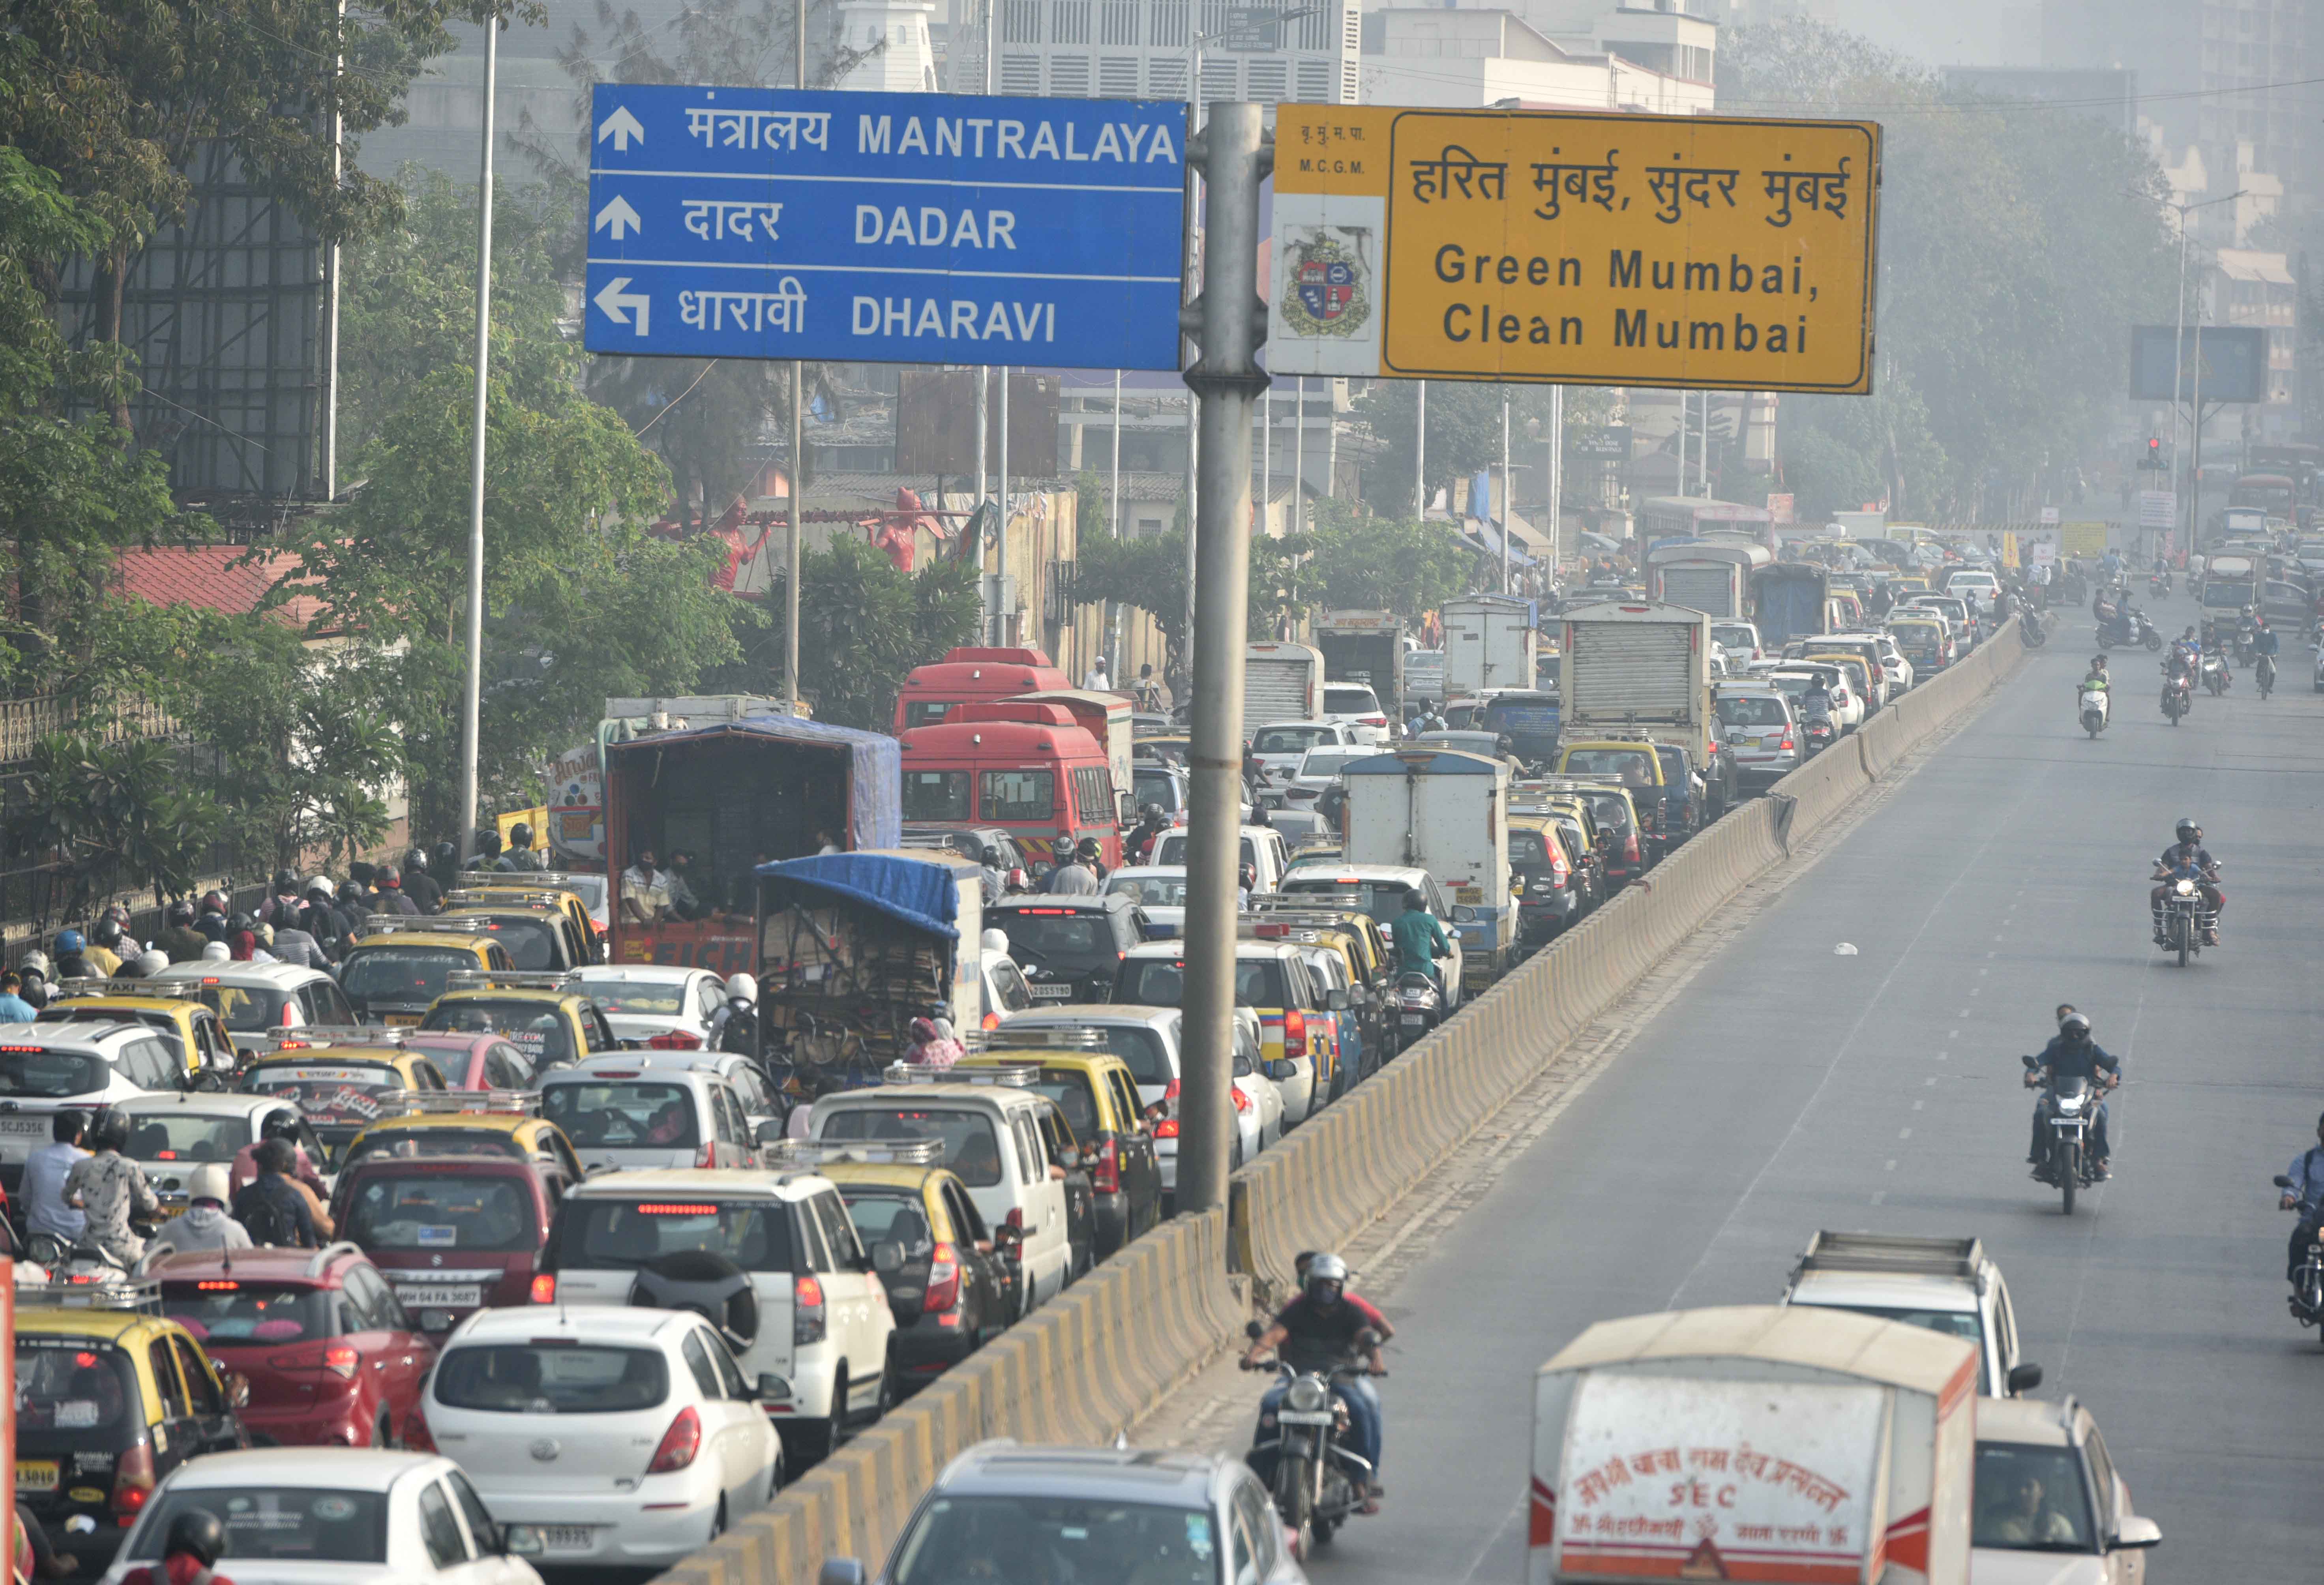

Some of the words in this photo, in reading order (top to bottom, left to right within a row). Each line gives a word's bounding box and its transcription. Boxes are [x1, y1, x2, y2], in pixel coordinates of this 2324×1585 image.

[685, 92, 831, 152] मंत्रालय
[858, 114, 1177, 164] MANTRALAYA
[1410, 145, 1508, 203] हरित
[1529, 146, 1631, 220] मुंबई,
[1645, 153, 1740, 224] सुंदर
[1761, 154, 1851, 228] मुंबई
[682, 200, 783, 242] दादर
[855, 205, 1017, 249] DADAR
[1435, 244, 1581, 287] Green
[1610, 249, 1818, 303] Mumbai,
[679, 276, 807, 333] धारावी
[852, 296, 1055, 342] DHARAVI
[1443, 303, 1583, 346] Clean
[1614, 309, 1806, 354] Mumbai
[106, 983, 136, 991] TAXI
